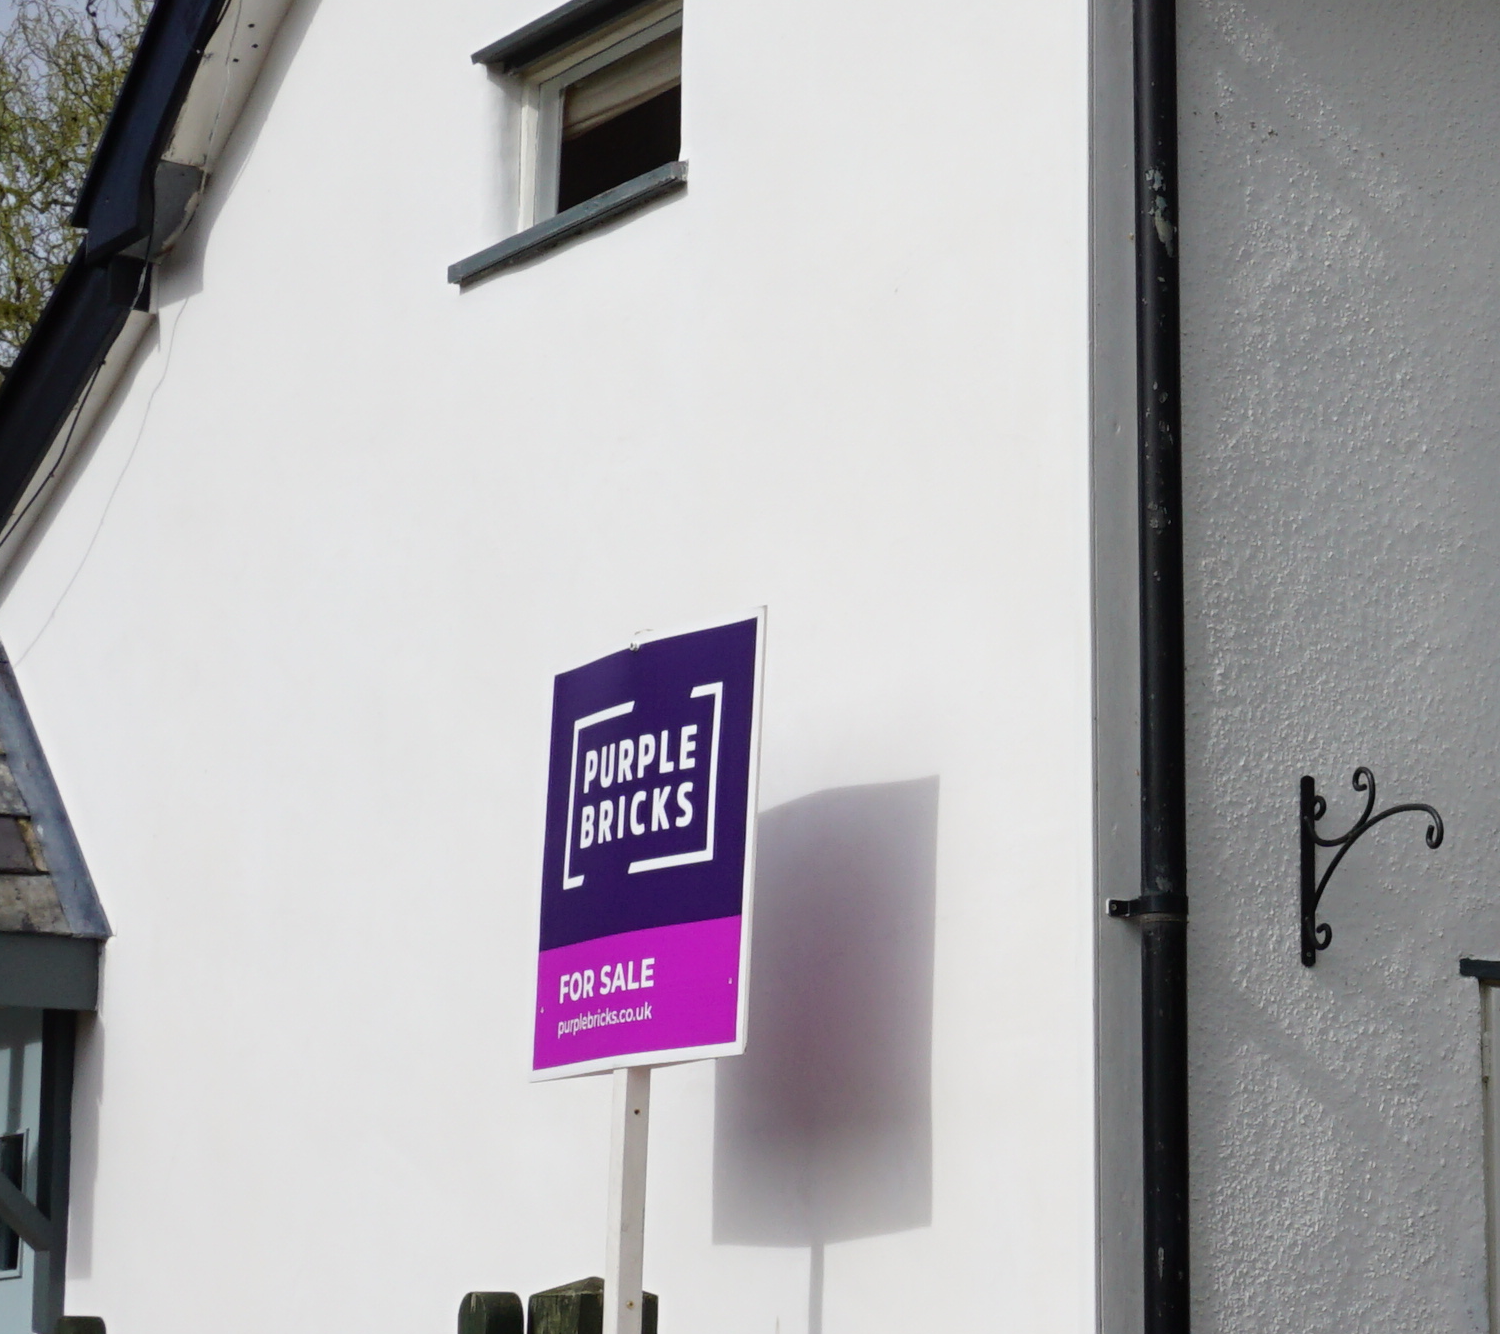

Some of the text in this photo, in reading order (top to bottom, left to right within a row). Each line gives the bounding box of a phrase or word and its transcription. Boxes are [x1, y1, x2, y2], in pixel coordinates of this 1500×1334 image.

[583, 724, 698, 794] PURPLE
[580, 781, 694, 849] BRICKS
[559, 957, 655, 1004] FOR SALE
[558, 1001, 652, 1039] purplebricks.co.uk
